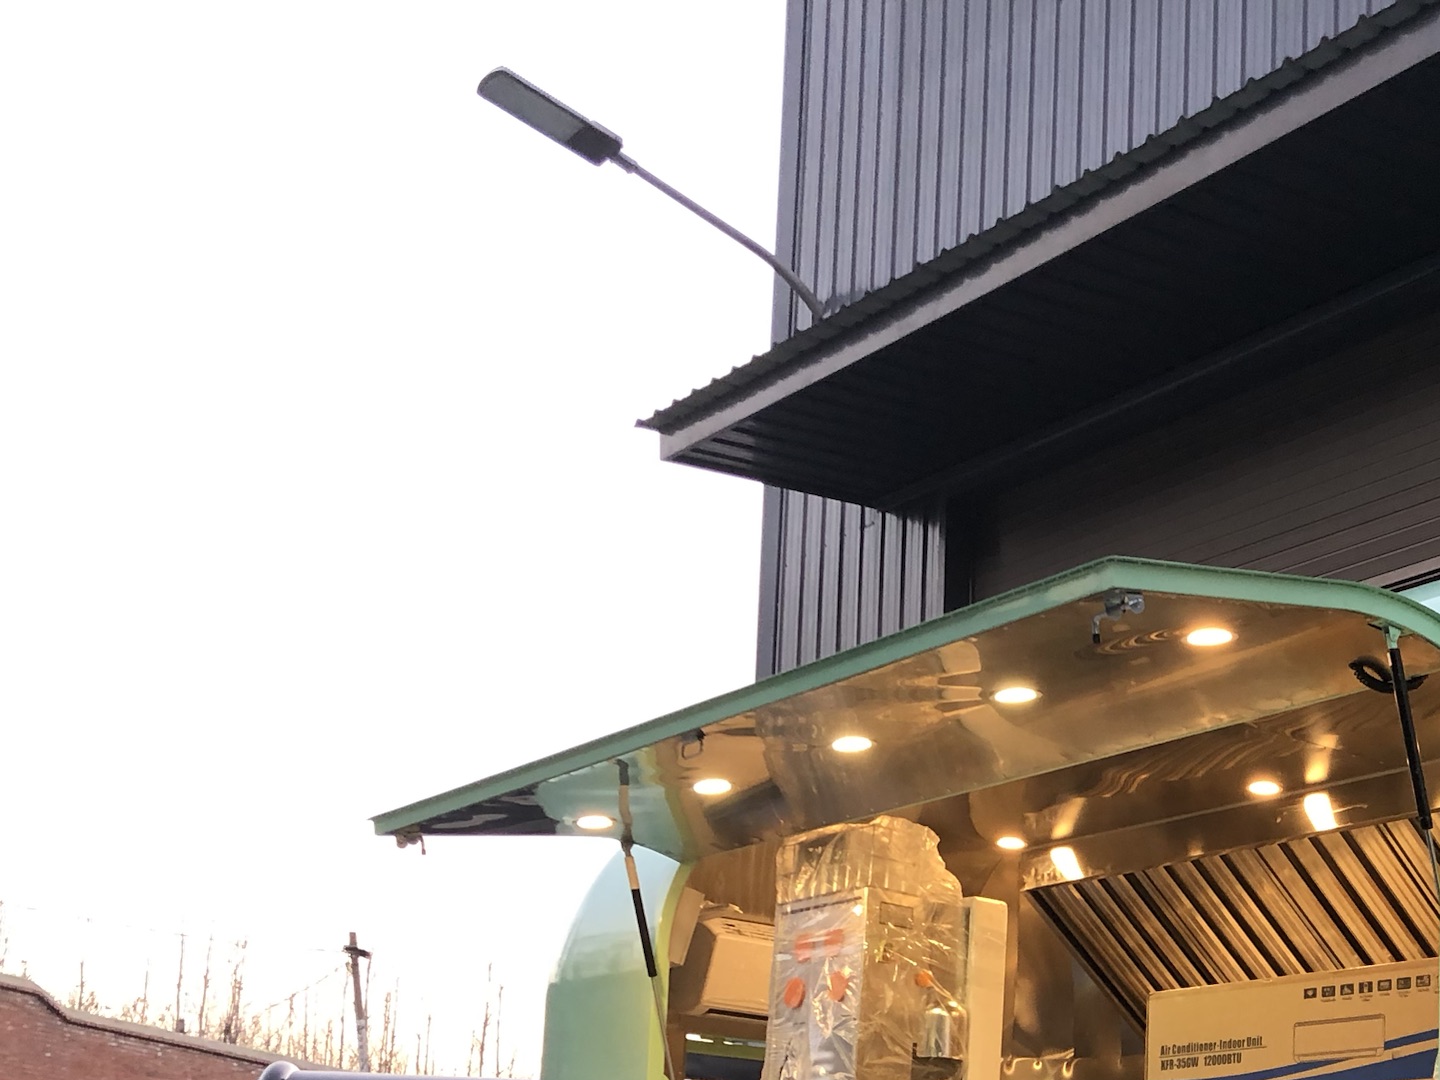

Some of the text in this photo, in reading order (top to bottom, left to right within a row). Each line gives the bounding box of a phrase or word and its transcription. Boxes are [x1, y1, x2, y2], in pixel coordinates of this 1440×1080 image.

[1160, 1035, 1263, 1056] Air Conditioner-Indoor Unit
[1160, 1052, 1242, 1071] KFR-35GW 12000BTU
